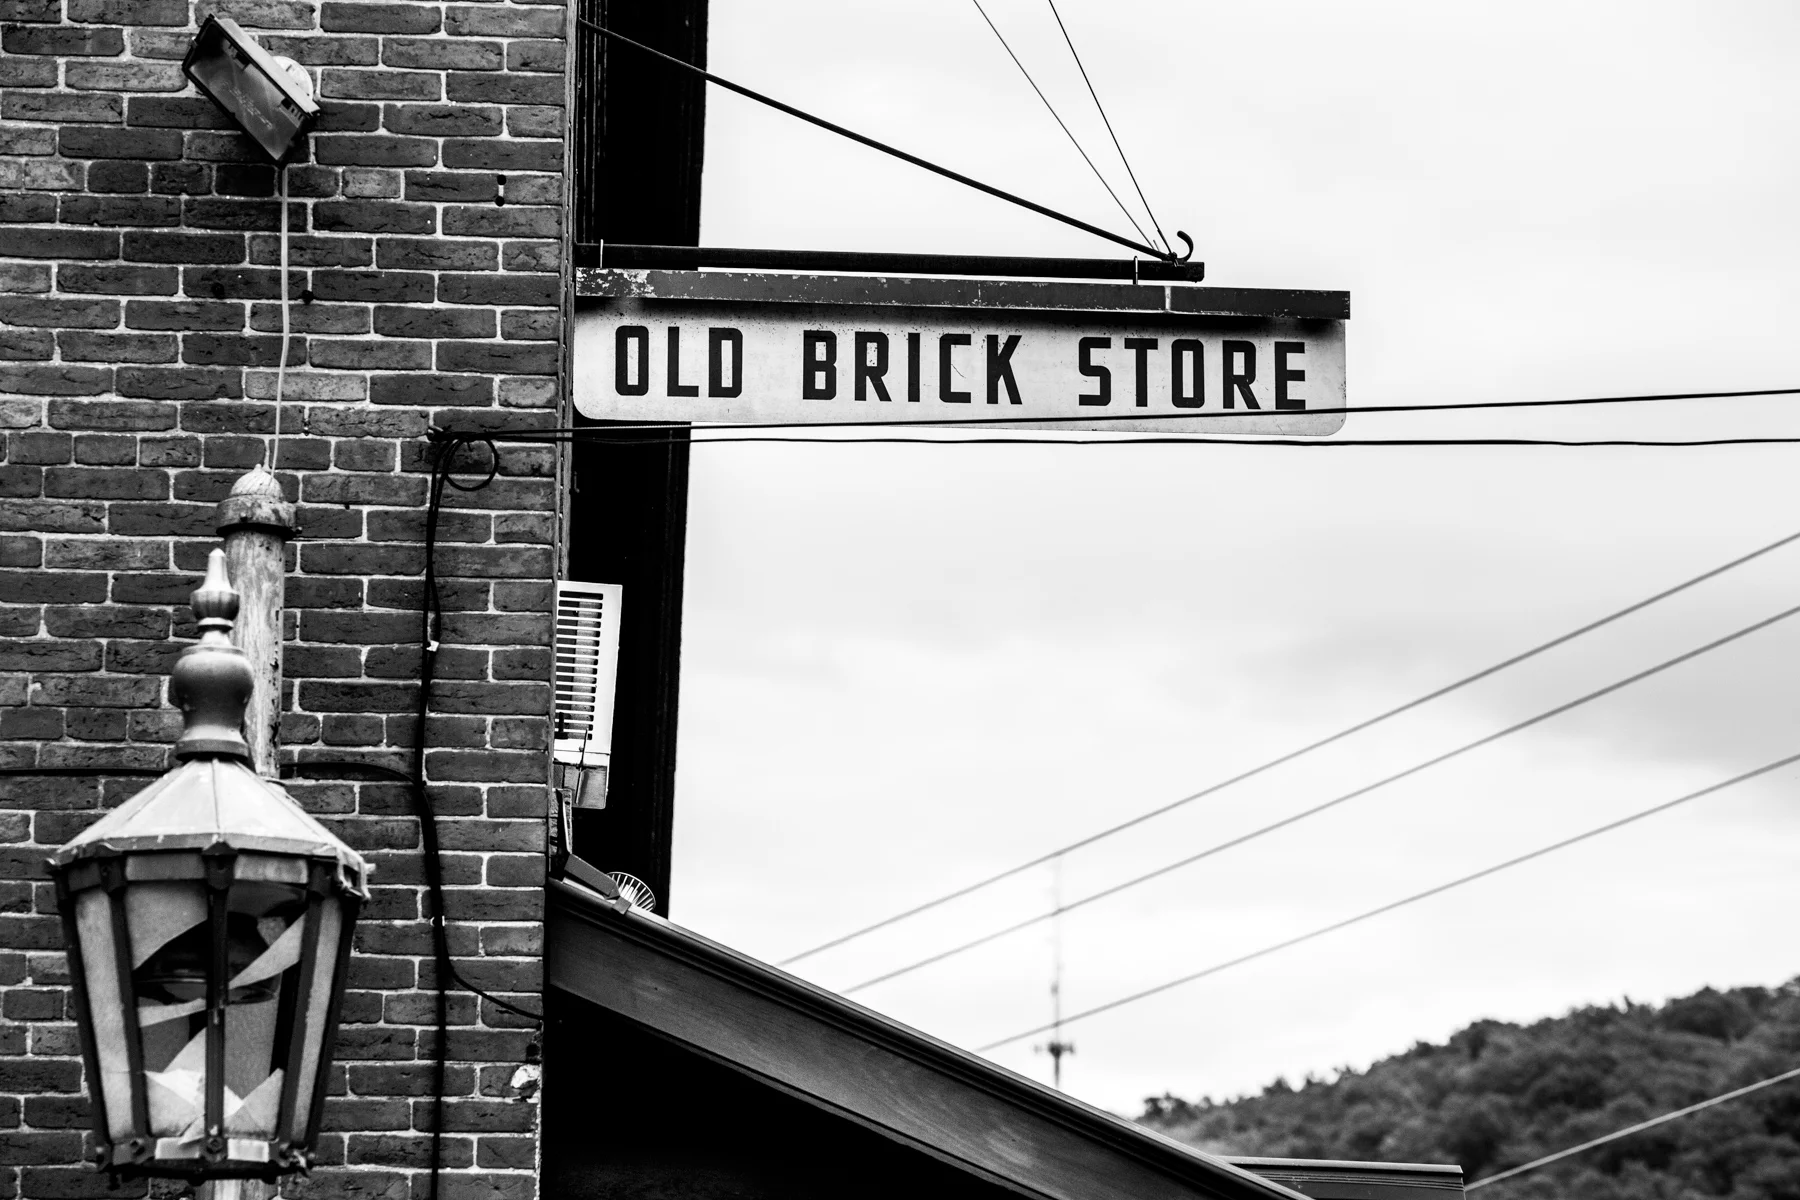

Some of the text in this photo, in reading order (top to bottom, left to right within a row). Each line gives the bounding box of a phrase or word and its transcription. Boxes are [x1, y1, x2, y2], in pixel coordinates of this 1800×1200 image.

[616, 326, 1306, 411] OLD BRICK STORE
